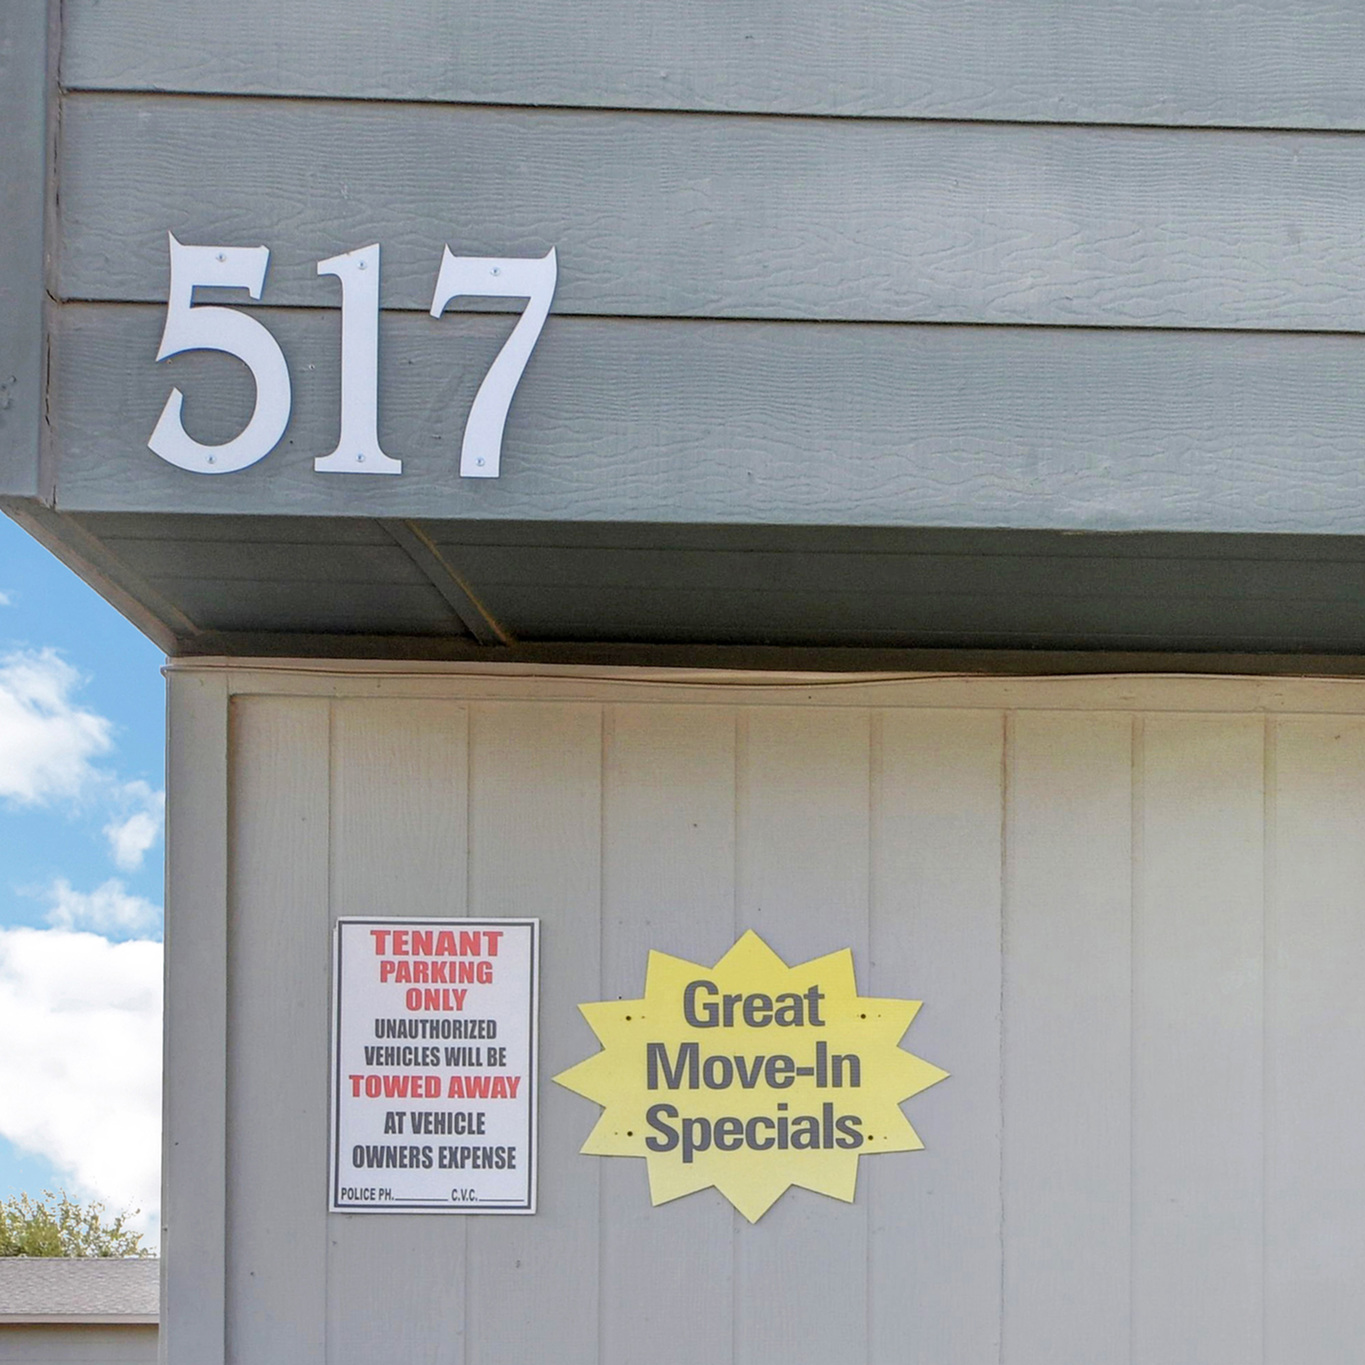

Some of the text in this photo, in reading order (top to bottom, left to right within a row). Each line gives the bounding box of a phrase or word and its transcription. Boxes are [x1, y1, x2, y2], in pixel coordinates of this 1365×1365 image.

[147, 230, 558, 478] 517
[370, 930, 503, 956] TENANT
[380, 961, 493, 984] PARKING
[406, 988, 467, 1011] ONLY
[683, 979, 825, 1028] Great
[375, 1019, 497, 1040] UNAUTHORIZED
[364, 1046, 507, 1067] VEHICLES WILL BE
[646, 1040, 861, 1091] Move-In
[349, 1075, 521, 1099] TOWED AWAY
[384, 1111, 485, 1135] AT VEHICLE
[645, 1101, 864, 1163] Specials
[352, 1145, 516, 1170] OWNERS EXPENSE
[341, 1187, 478, 1202] POLICE PH. C.V.C.
